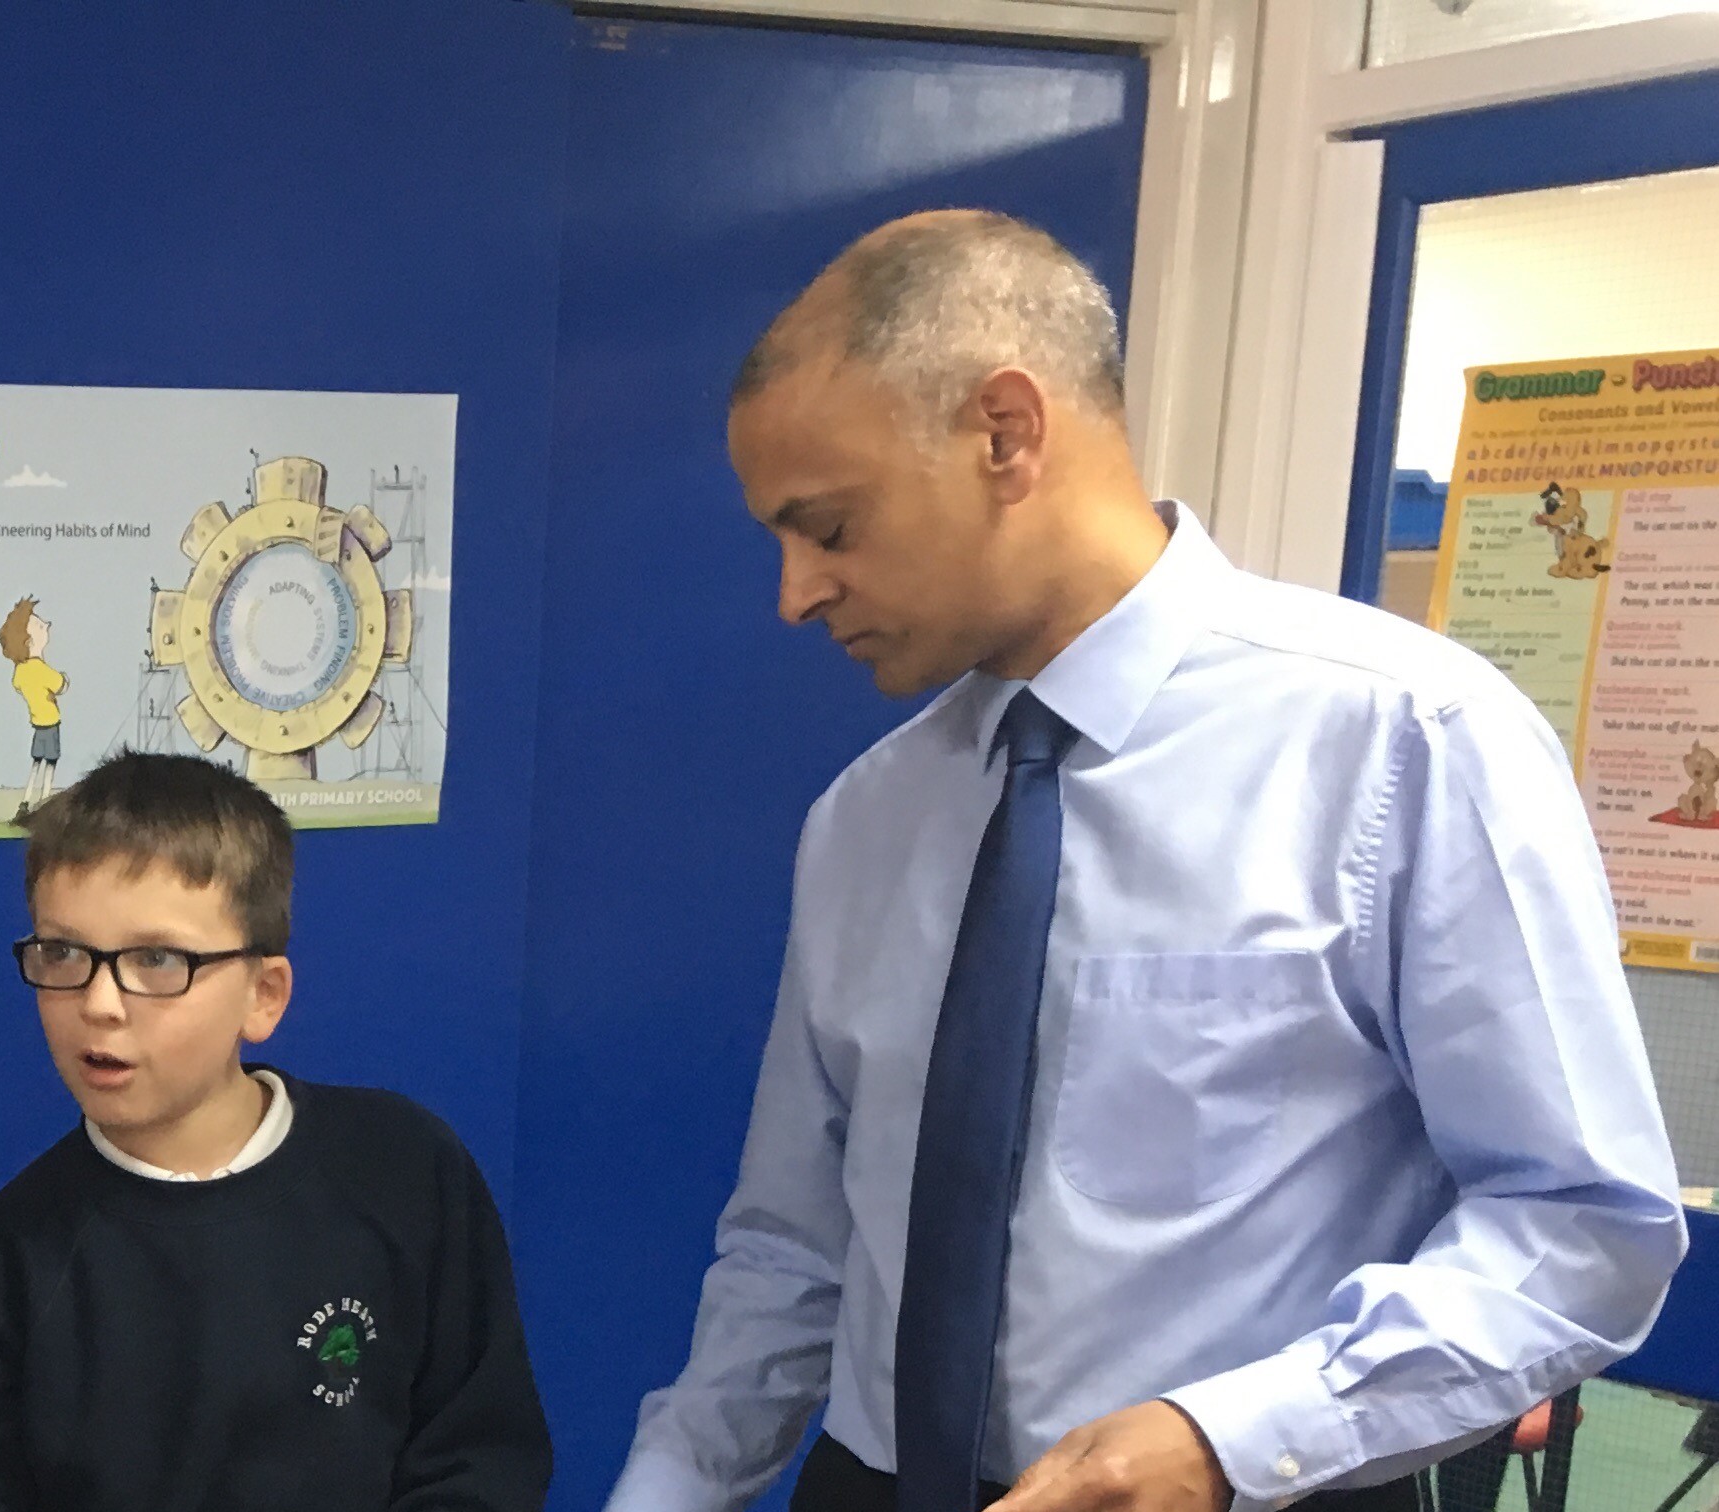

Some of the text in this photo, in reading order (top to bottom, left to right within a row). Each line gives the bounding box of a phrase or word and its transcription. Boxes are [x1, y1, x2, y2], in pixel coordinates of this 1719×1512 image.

[1474, 369, 1606, 403] Grammar
[1538, 404, 1628, 422] Consonants
[1634, 400, 1664, 416] and
[55, 523, 97, 537] Habits
[101, 523, 114, 537] of
[117, 523, 150, 537] Mind
[269, 581, 315, 605] ADAPTING
[220, 577, 305, 706] CREATIVE PROBLEM SOLVING
[307, 607, 326, 661] SYSTEMS
[314, 578, 349, 691] PROBLEM FINDING
[300, 791, 364, 805] PRIMARY
[367, 789, 423, 803] SCHOOL
[297, 1298, 377, 1349] RODE HEATH
